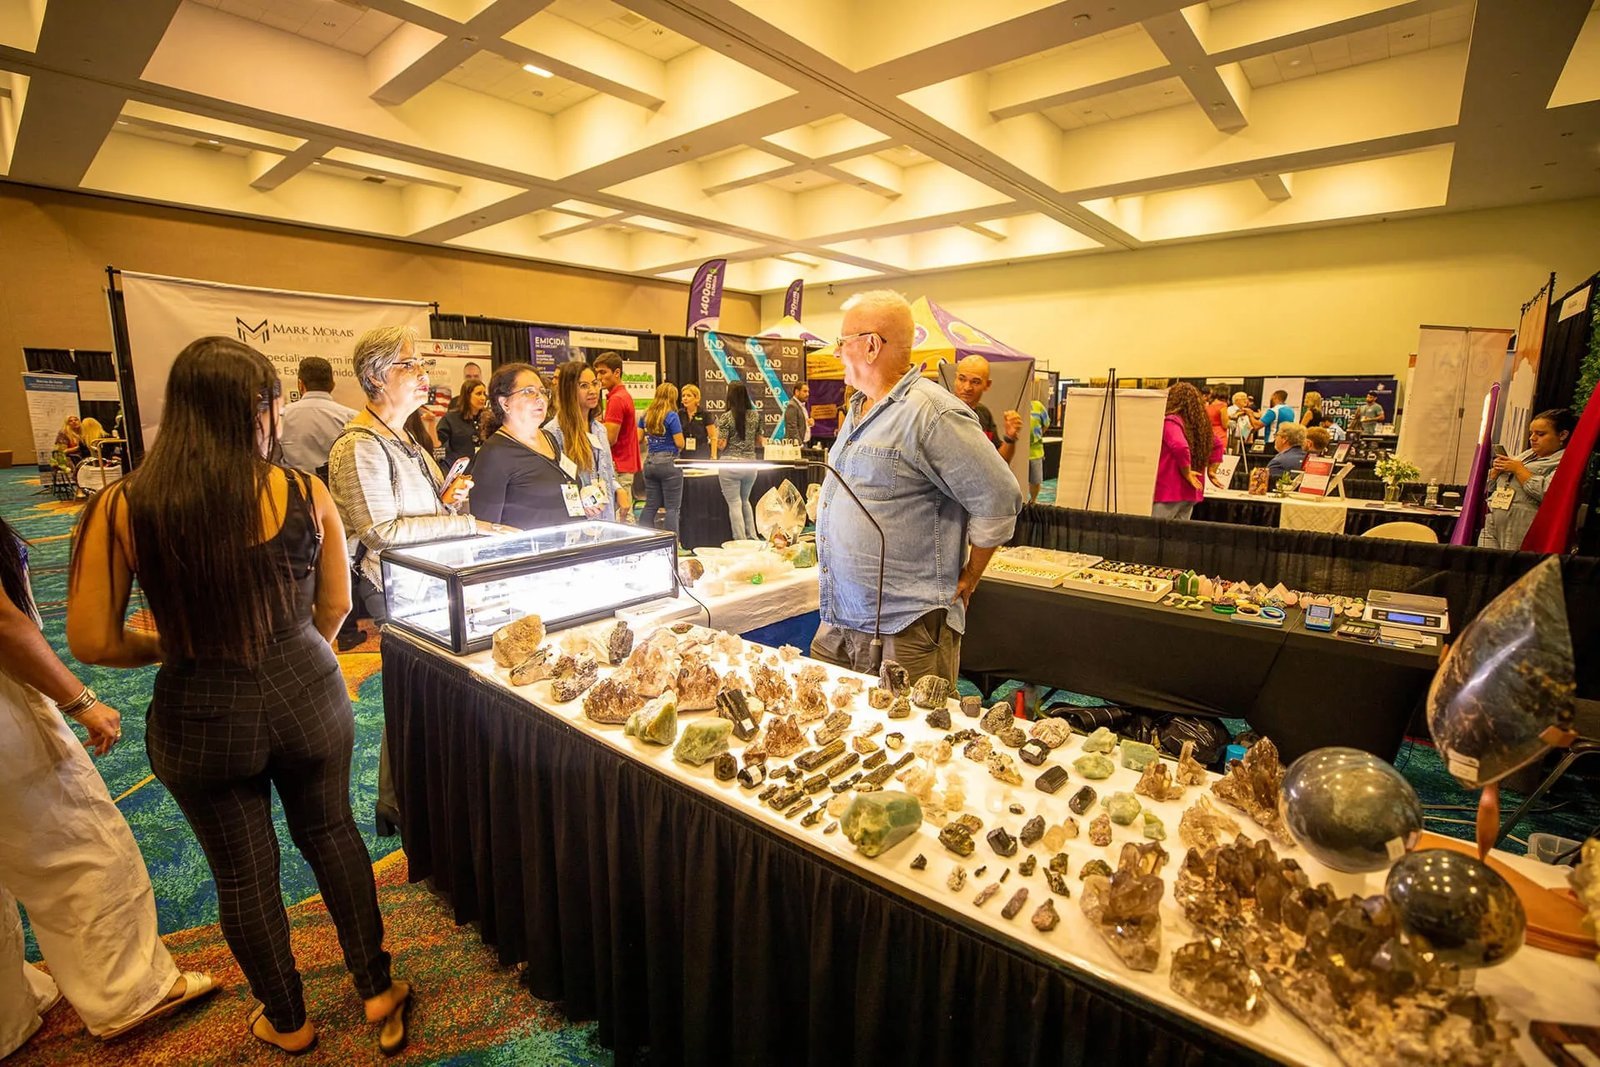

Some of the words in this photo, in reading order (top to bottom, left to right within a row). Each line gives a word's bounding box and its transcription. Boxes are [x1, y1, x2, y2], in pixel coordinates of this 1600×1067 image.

[535, 336, 566, 346] EMICIDA
[782, 346, 798, 355] KND
[725, 355, 745, 366] KND
[764, 358, 782, 368] KND
[704, 369, 725, 379] KND
[745, 371, 764, 381] KND
[782, 373, 798, 382] KND
[705, 400, 726, 409] KND
[1321, 399, 1341, 407] me
[764, 413, 781, 422] KND
